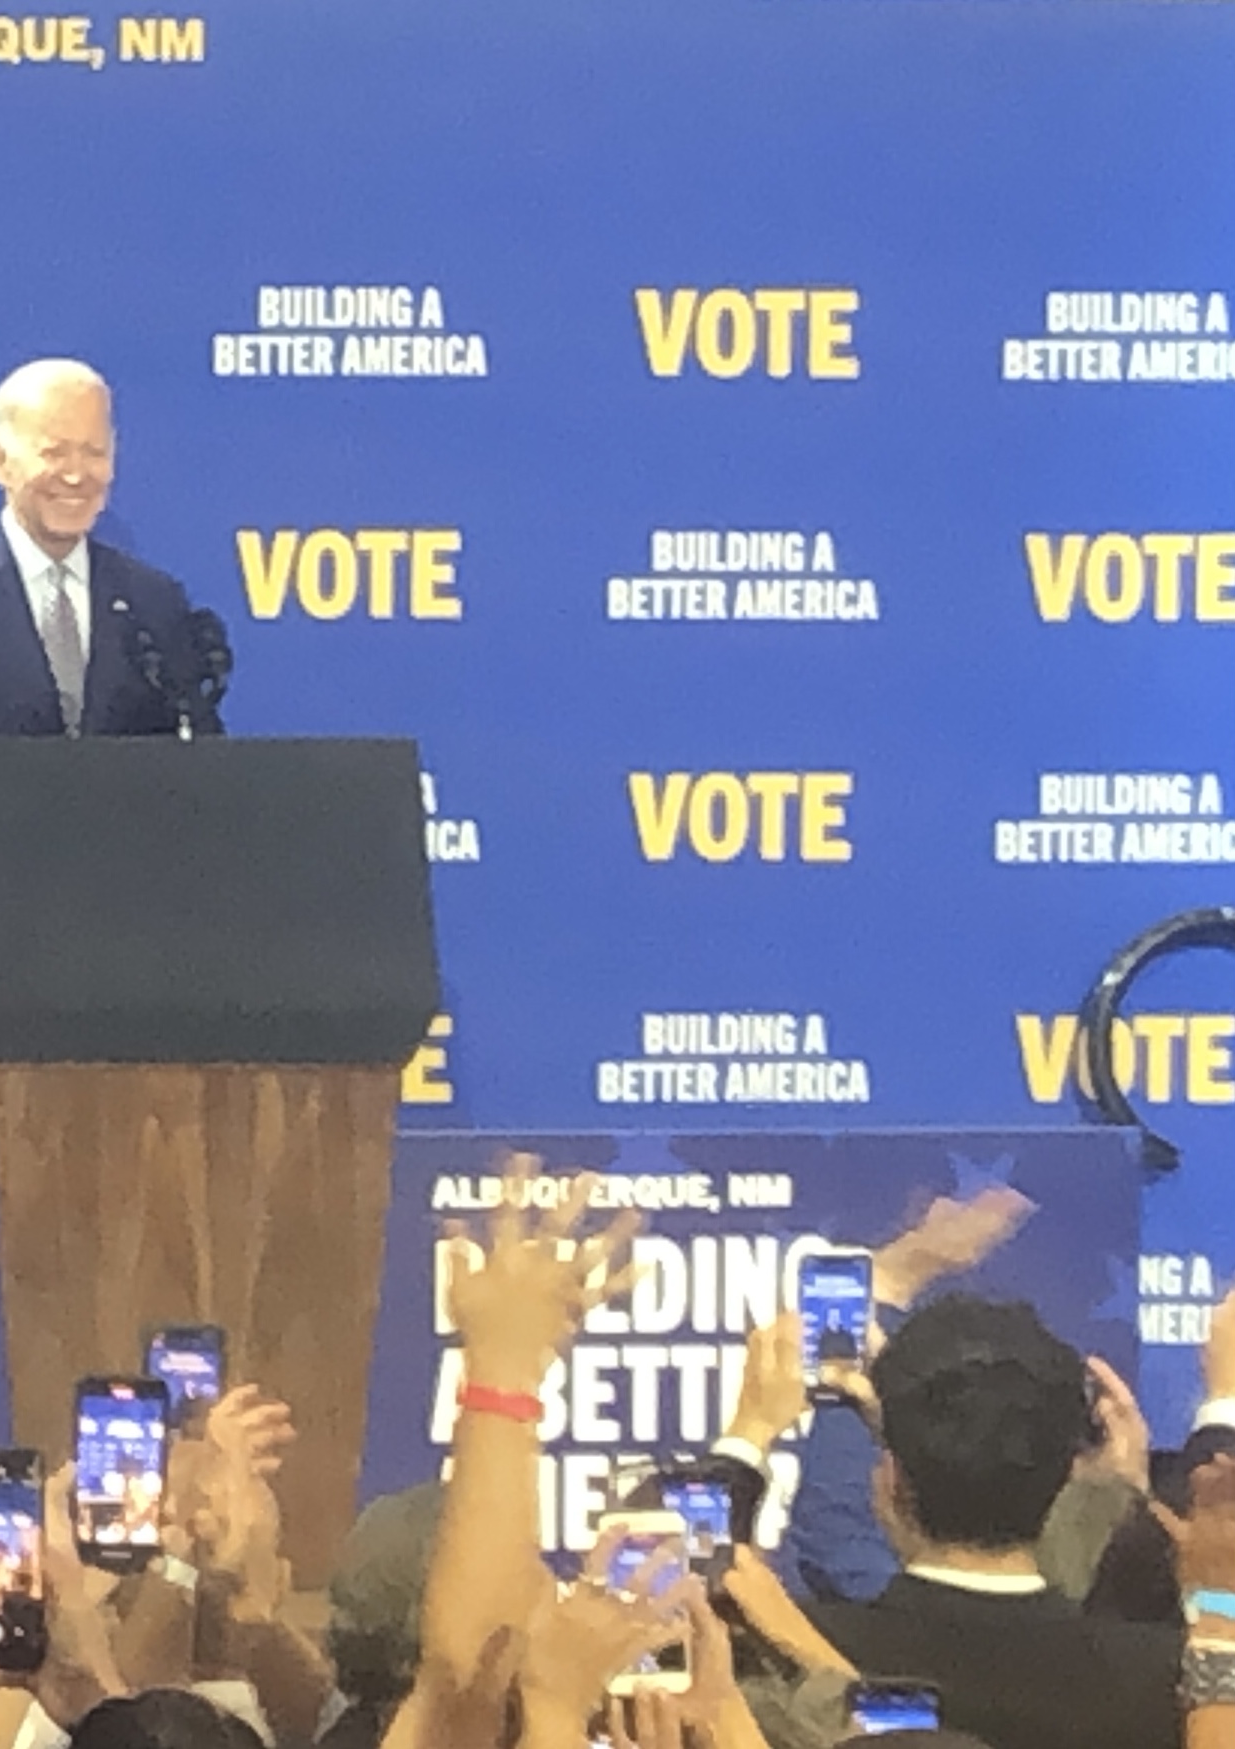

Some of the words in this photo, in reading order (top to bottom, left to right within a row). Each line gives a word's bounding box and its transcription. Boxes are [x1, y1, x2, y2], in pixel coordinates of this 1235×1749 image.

[119, 17, 205, 63] NM
[258, 286, 415, 329] BUILDING
[418, 286, 444, 329] A
[1046, 291, 1201, 335] BUILDING
[1203, 291, 1230, 335] A
[213, 333, 336, 377] BETTER
[340, 333, 488, 377] AMERICA
[634, 288, 861, 379] VOTE
[1002, 338, 1123, 382] BETTER
[1126, 338, 1235, 382] AMERI
[651, 530, 806, 573] BUILDING
[811, 530, 836, 573] A
[236, 528, 463, 620] VOTE
[1024, 531, 1235, 623] VOTE
[607, 577, 729, 621] BETTER
[732, 577, 879, 621] AMERICA
[628, 771, 853, 862] VOTE
[1040, 773, 1194, 816] BUILDING
[1197, 773, 1222, 816] A
[995, 820, 1116, 863] BETTER
[1119, 820, 1235, 863] AMERIC
[643, 1012, 798, 1056] BUILDING
[802, 1012, 828, 1056] A
[597, 1060, 720, 1103] BETTER
[723, 1060, 870, 1103] AMERICA
[728, 1173, 793, 1208] NM
[1188, 1255, 1214, 1297] A
